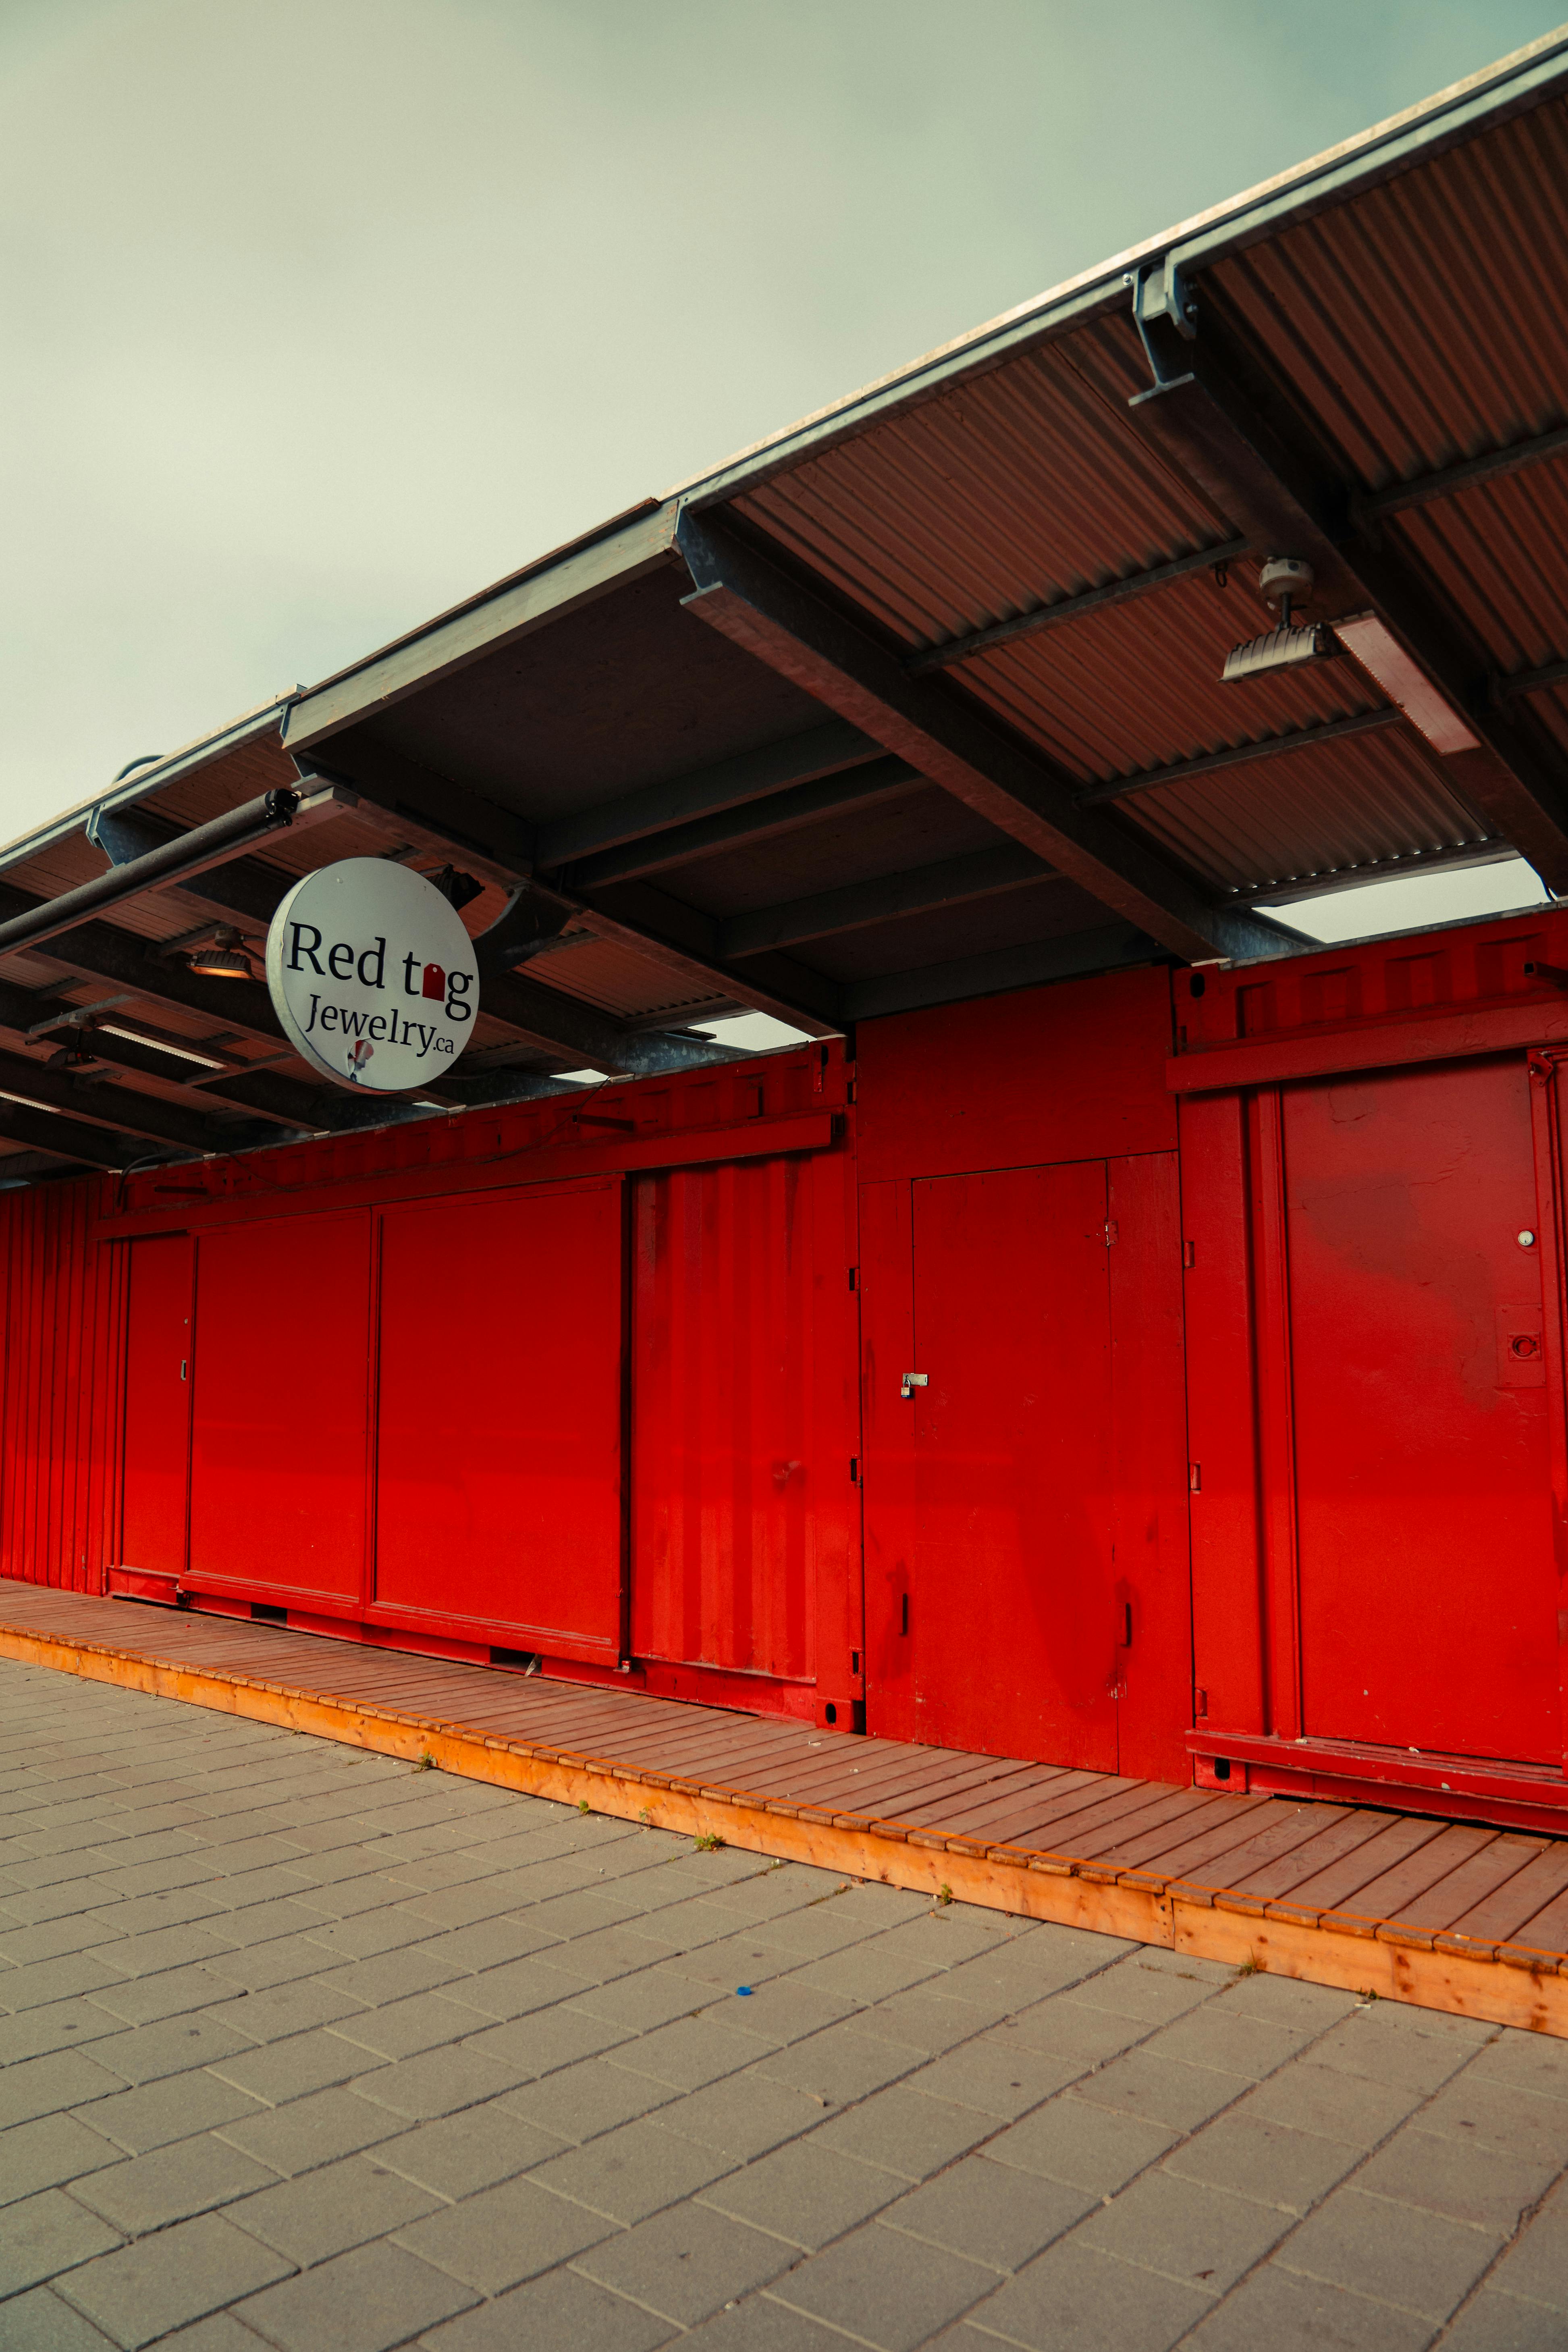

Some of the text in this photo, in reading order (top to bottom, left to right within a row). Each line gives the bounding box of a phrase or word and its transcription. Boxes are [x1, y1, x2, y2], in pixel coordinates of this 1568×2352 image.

[287, 922, 474, 1022] Red tg
[305, 994, 455, 1058] Jewelry.ca
